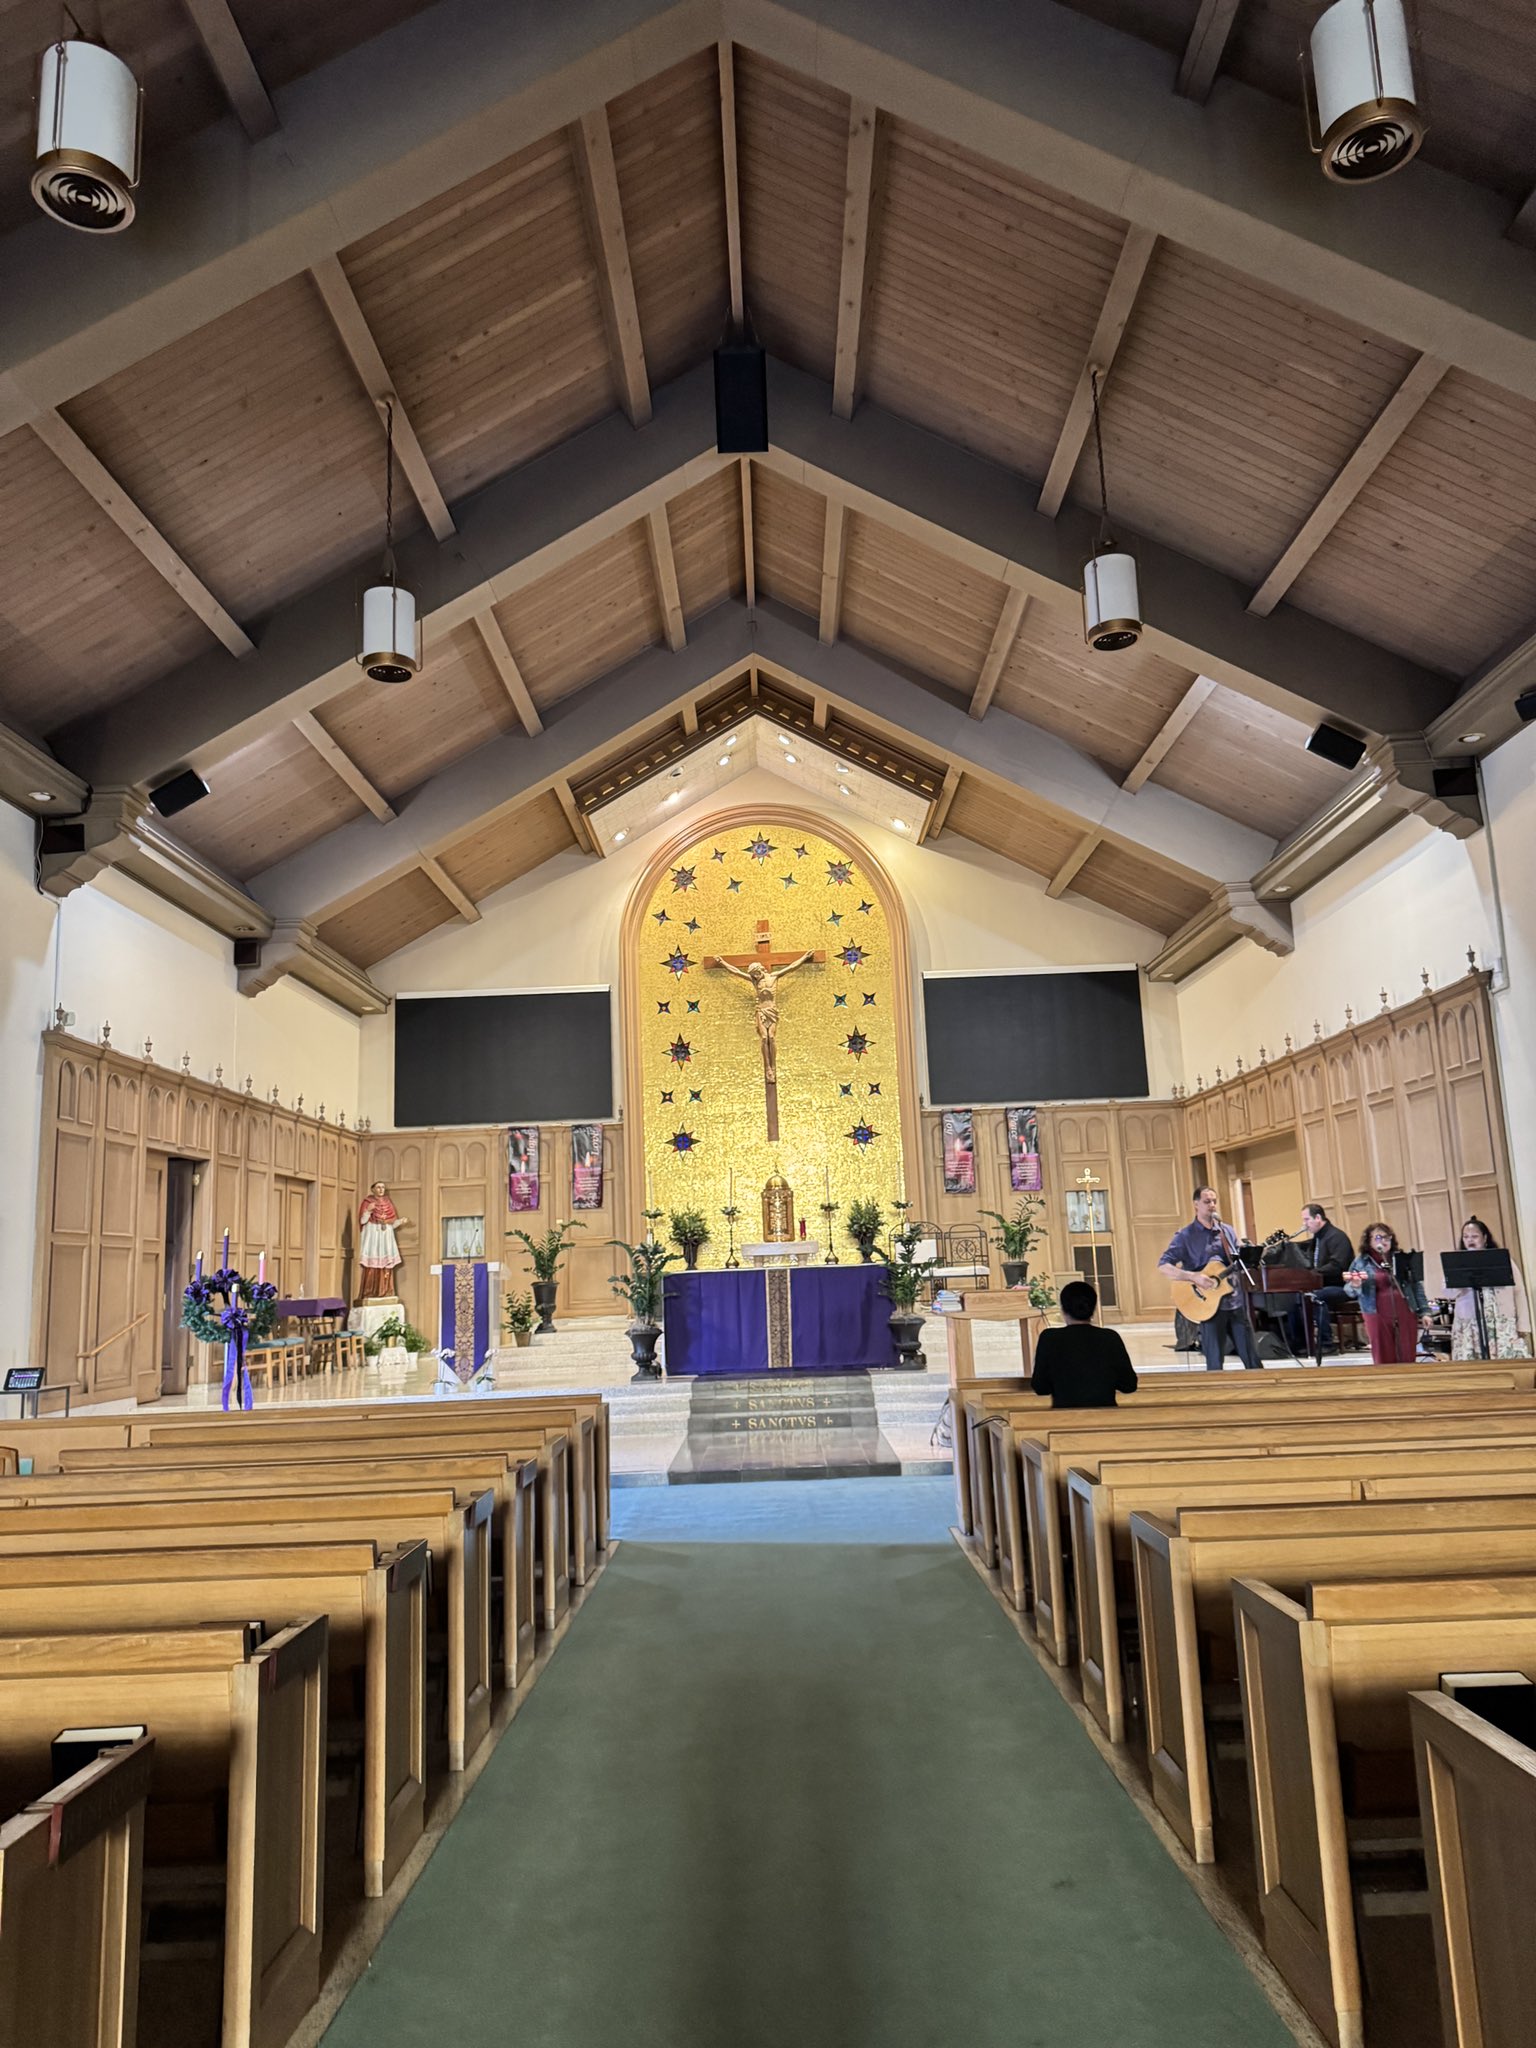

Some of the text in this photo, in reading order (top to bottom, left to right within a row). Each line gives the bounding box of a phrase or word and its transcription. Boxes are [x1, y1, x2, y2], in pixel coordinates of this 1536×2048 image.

[944, 1118, 954, 1136] Joy
[1009, 1114, 1019, 1140] Peace
[526, 1130, 537, 1156] Hope
[591, 1127, 600, 1156] Love
[748, 1416, 816, 1429] SANCTVS
